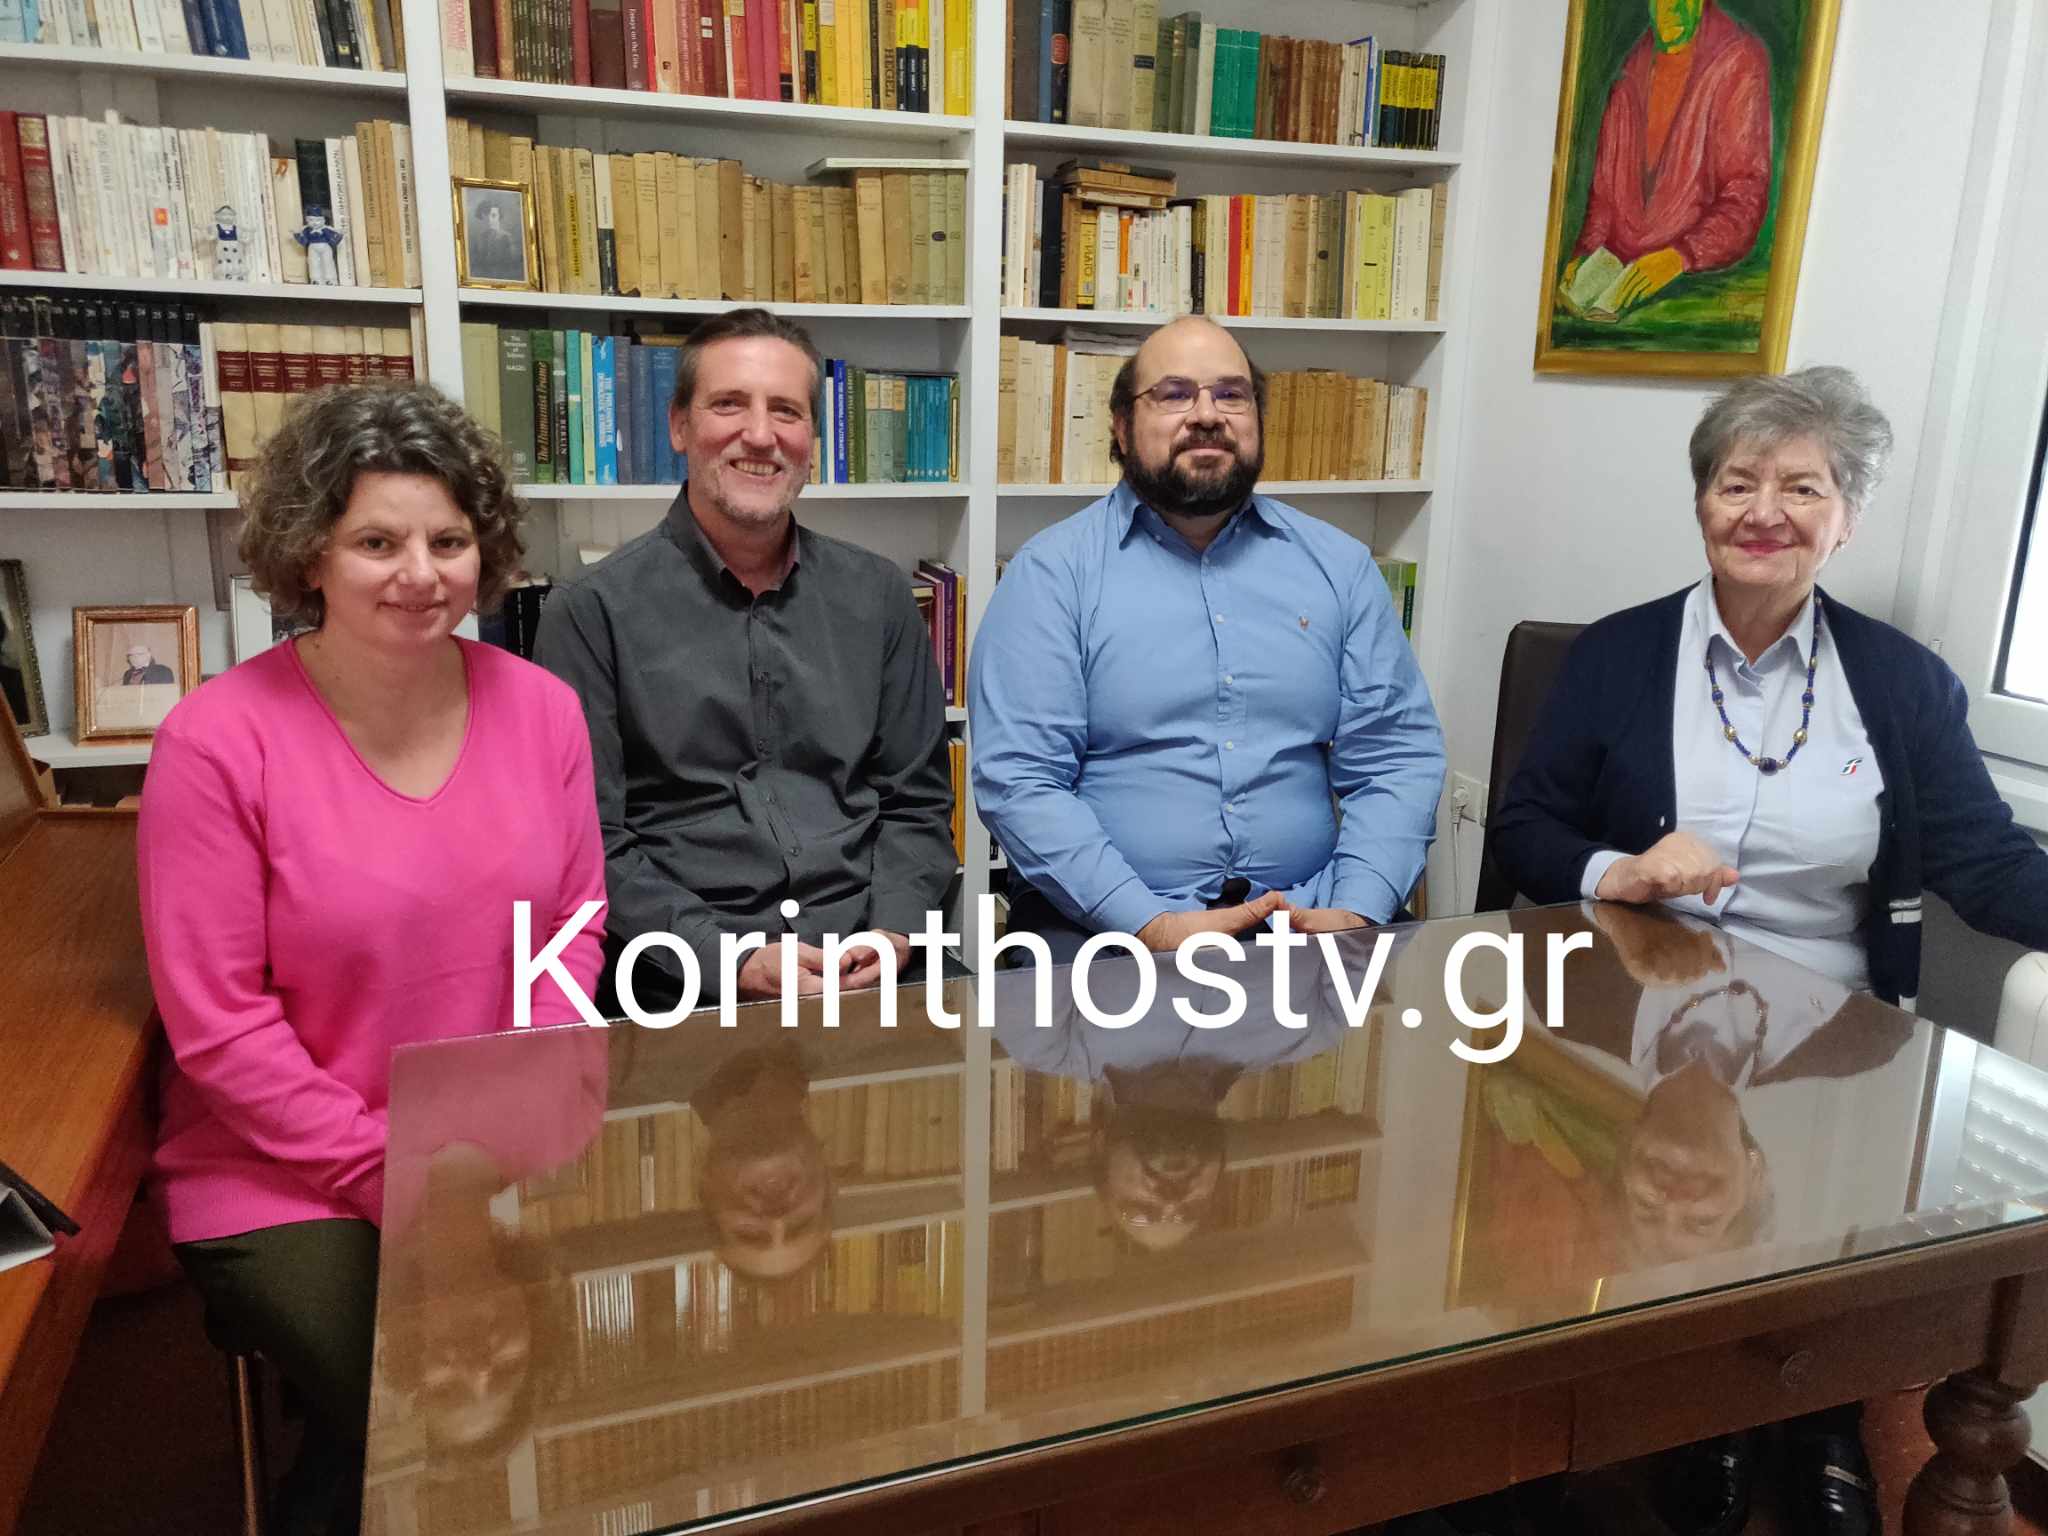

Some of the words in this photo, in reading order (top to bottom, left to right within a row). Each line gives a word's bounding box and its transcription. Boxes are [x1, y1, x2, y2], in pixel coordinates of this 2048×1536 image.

[884, 48, 896, 98] HEGEL
[1084, 245, 1092, 276] PLATO
[535, 361, 548, 393] Frame
